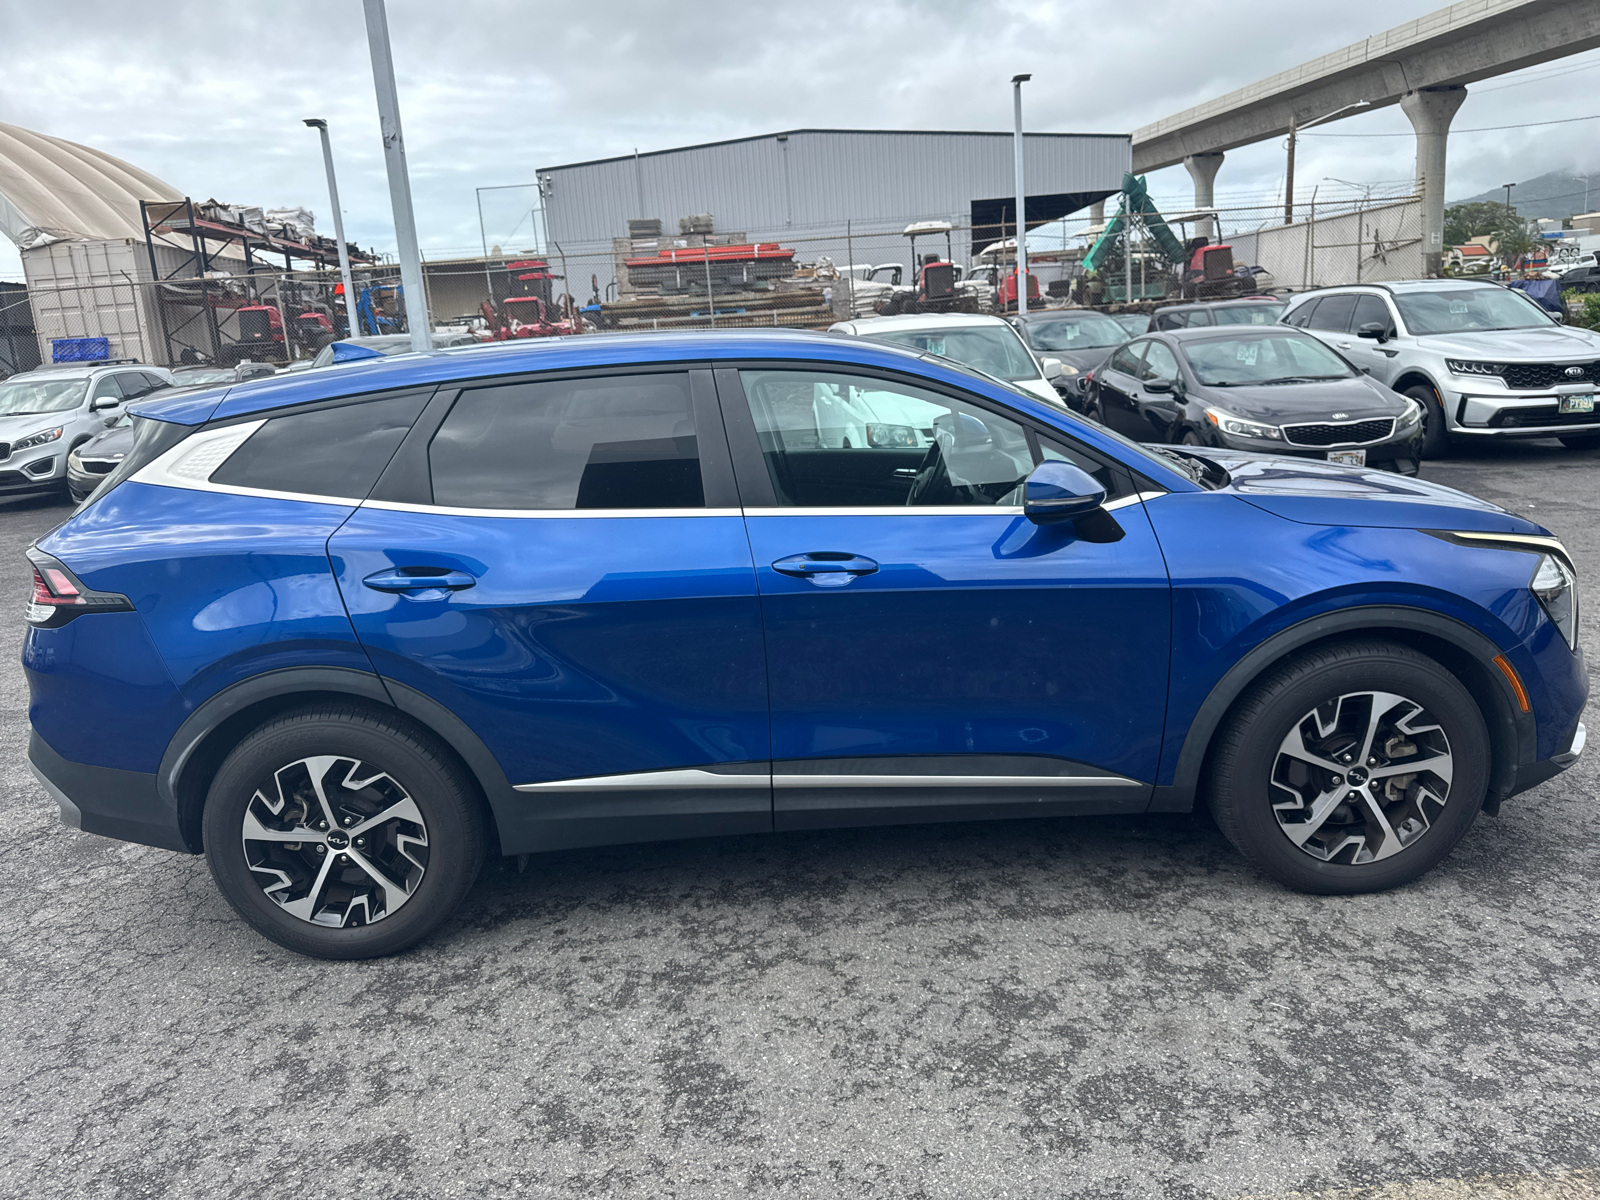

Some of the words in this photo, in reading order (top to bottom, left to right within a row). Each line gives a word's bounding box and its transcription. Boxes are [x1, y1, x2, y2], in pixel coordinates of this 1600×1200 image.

[1238, 348, 1256, 360] 904
[1566, 368, 1583, 376] KIA
[341, 731, 407, 765] KUMHO
[328, 836, 348, 845] KIA
